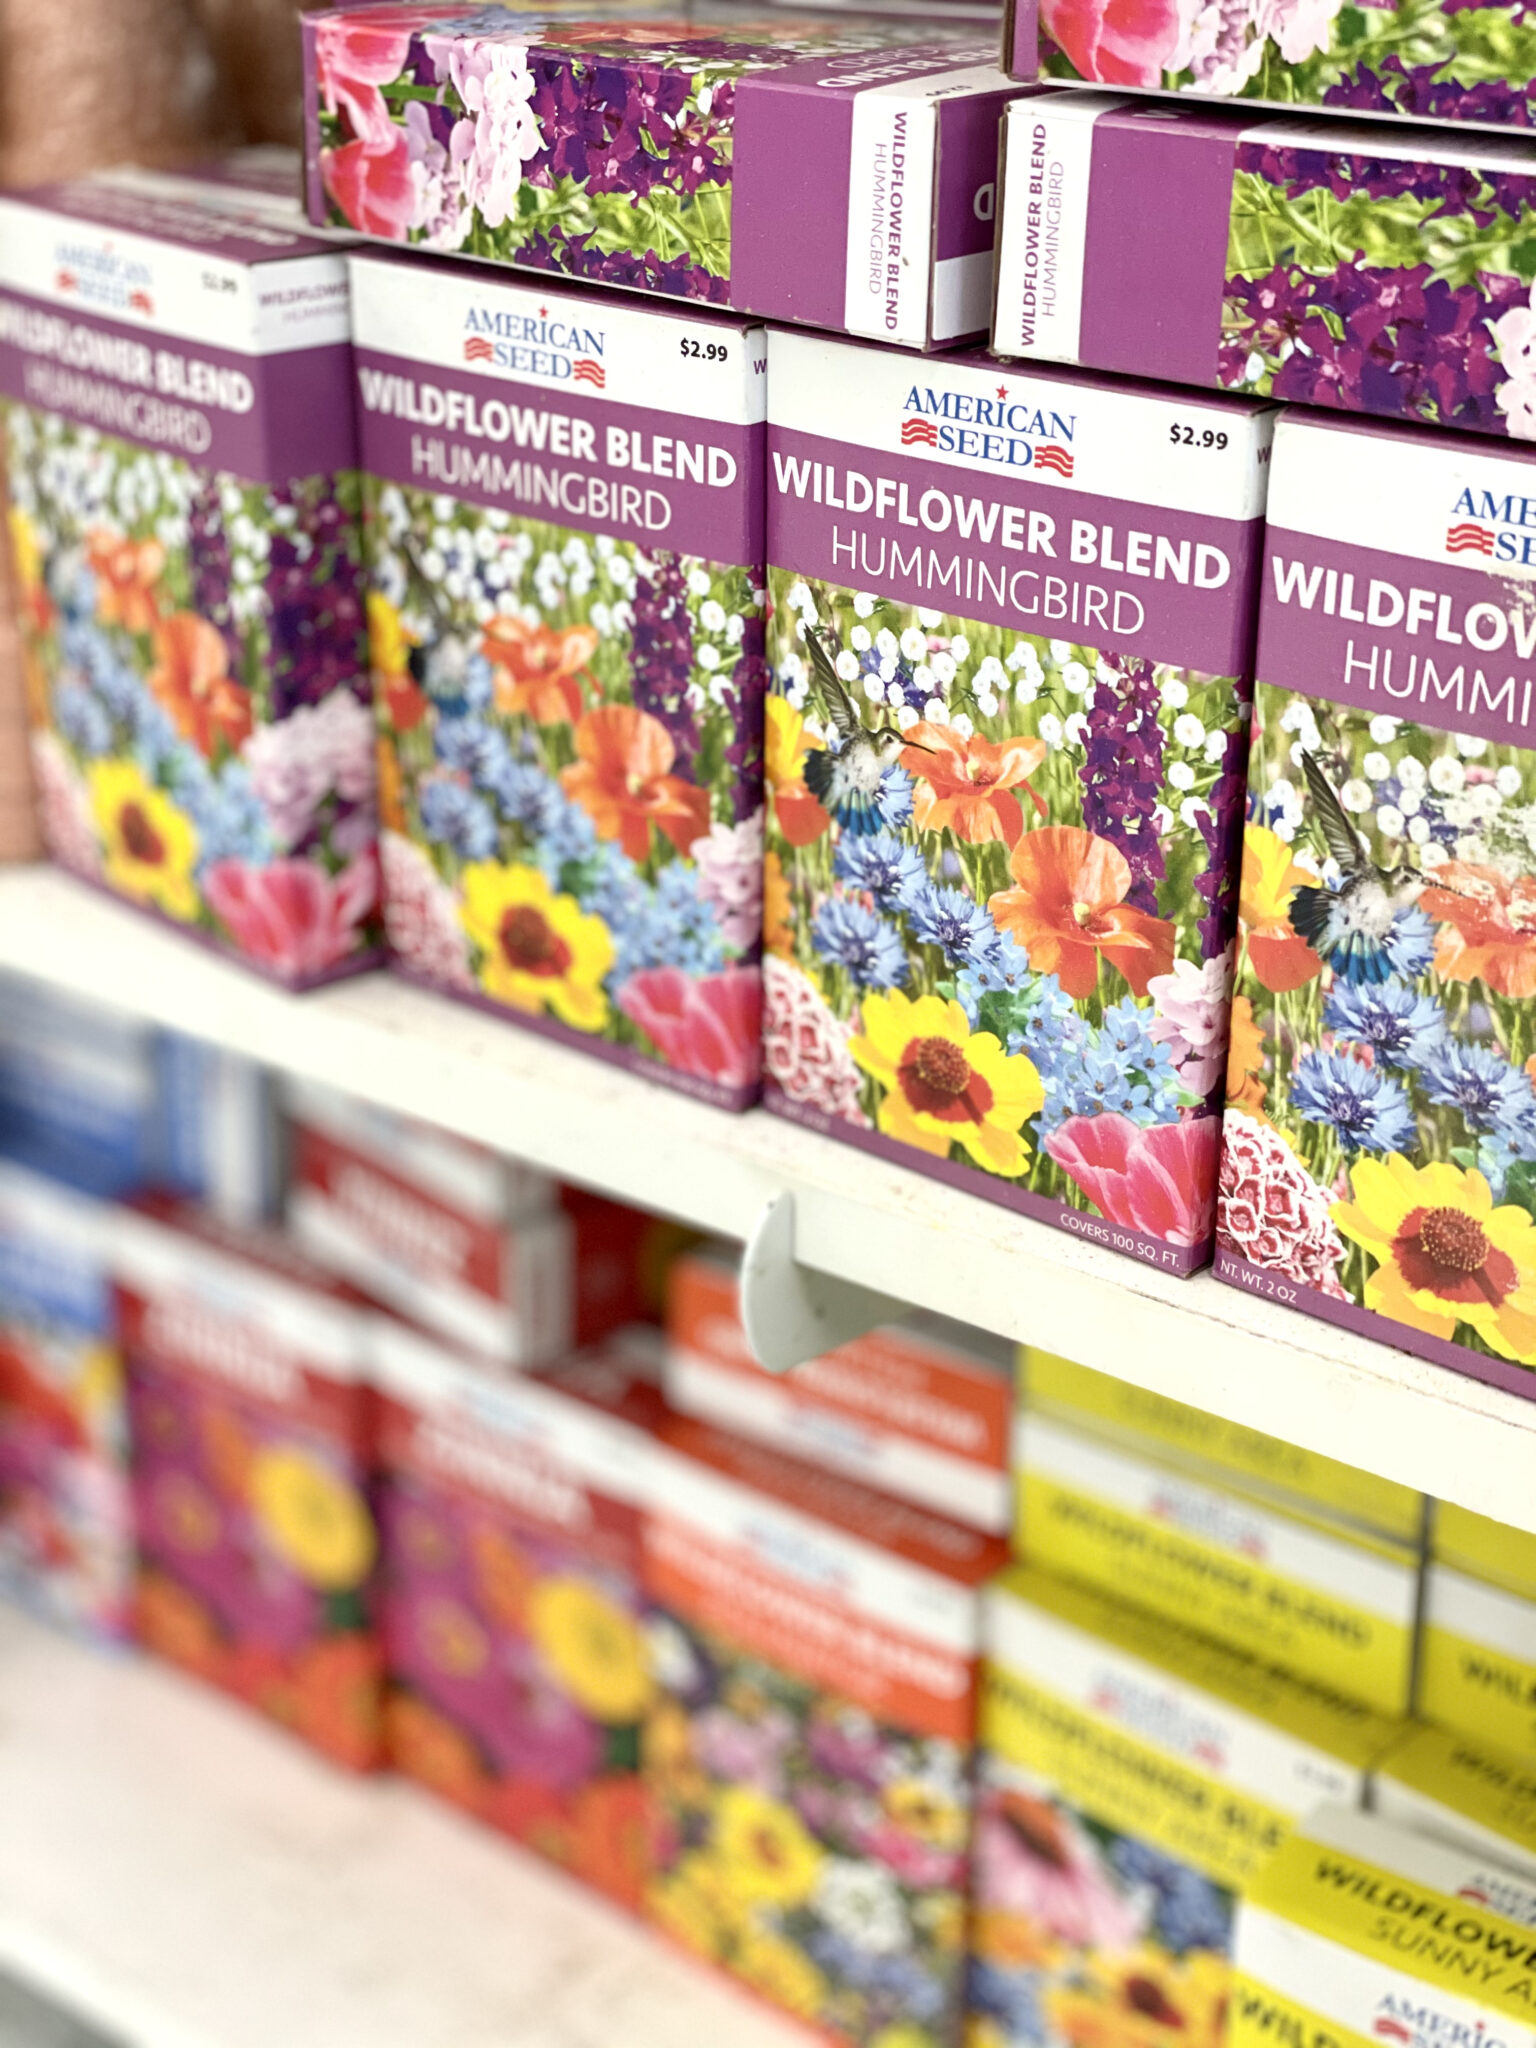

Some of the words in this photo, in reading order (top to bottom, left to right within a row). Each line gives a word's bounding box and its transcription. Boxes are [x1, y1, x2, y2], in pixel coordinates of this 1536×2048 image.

[888, 111, 908, 258] WILDFLOWER
[1029, 123, 1047, 195] BLEND
[869, 143, 887, 295] HUMMINGBIRD
[1042, 161, 1064, 317] HUMMINGBIRD
[885, 260, 900, 330] BLEND
[1021, 201, 1042, 346] WILDFLOWER
[464, 307, 606, 356] AMERICAN
[493, 344, 572, 379] SEED
[680, 338, 729, 362] $2.99
[155, 349, 254, 414] BLEND
[903, 386, 1077, 443] AMERICAN
[359, 367, 597, 463] WILDFLOWER
[606, 427, 737, 488] BLEND
[938, 426, 1033, 467] SEED
[1169, 423, 1229, 450] $2.99
[411, 434, 672, 531] HUMMINGBIRD
[773, 452, 1057, 558] WILDFLOWER
[1070, 520, 1231, 589] BLEND
[832, 525, 1145, 635] HUMMINGBIRD
[1344, 640, 1532, 727] HUMMI
[1060, 1213, 1109, 1242] COVERS
[1112, 1232, 1134, 1251] 100
[1137, 1242, 1159, 1262] SQ.
[1162, 1250, 1180, 1268] FT.
[1221, 1259, 1238, 1279] NT.
[1242, 1268, 1264, 1290] WT.
[1267, 1280, 1275, 1295] 2
[1277, 1283, 1297, 1304] OZ
[1370, 1914, 1504, 1985] SUNNY
